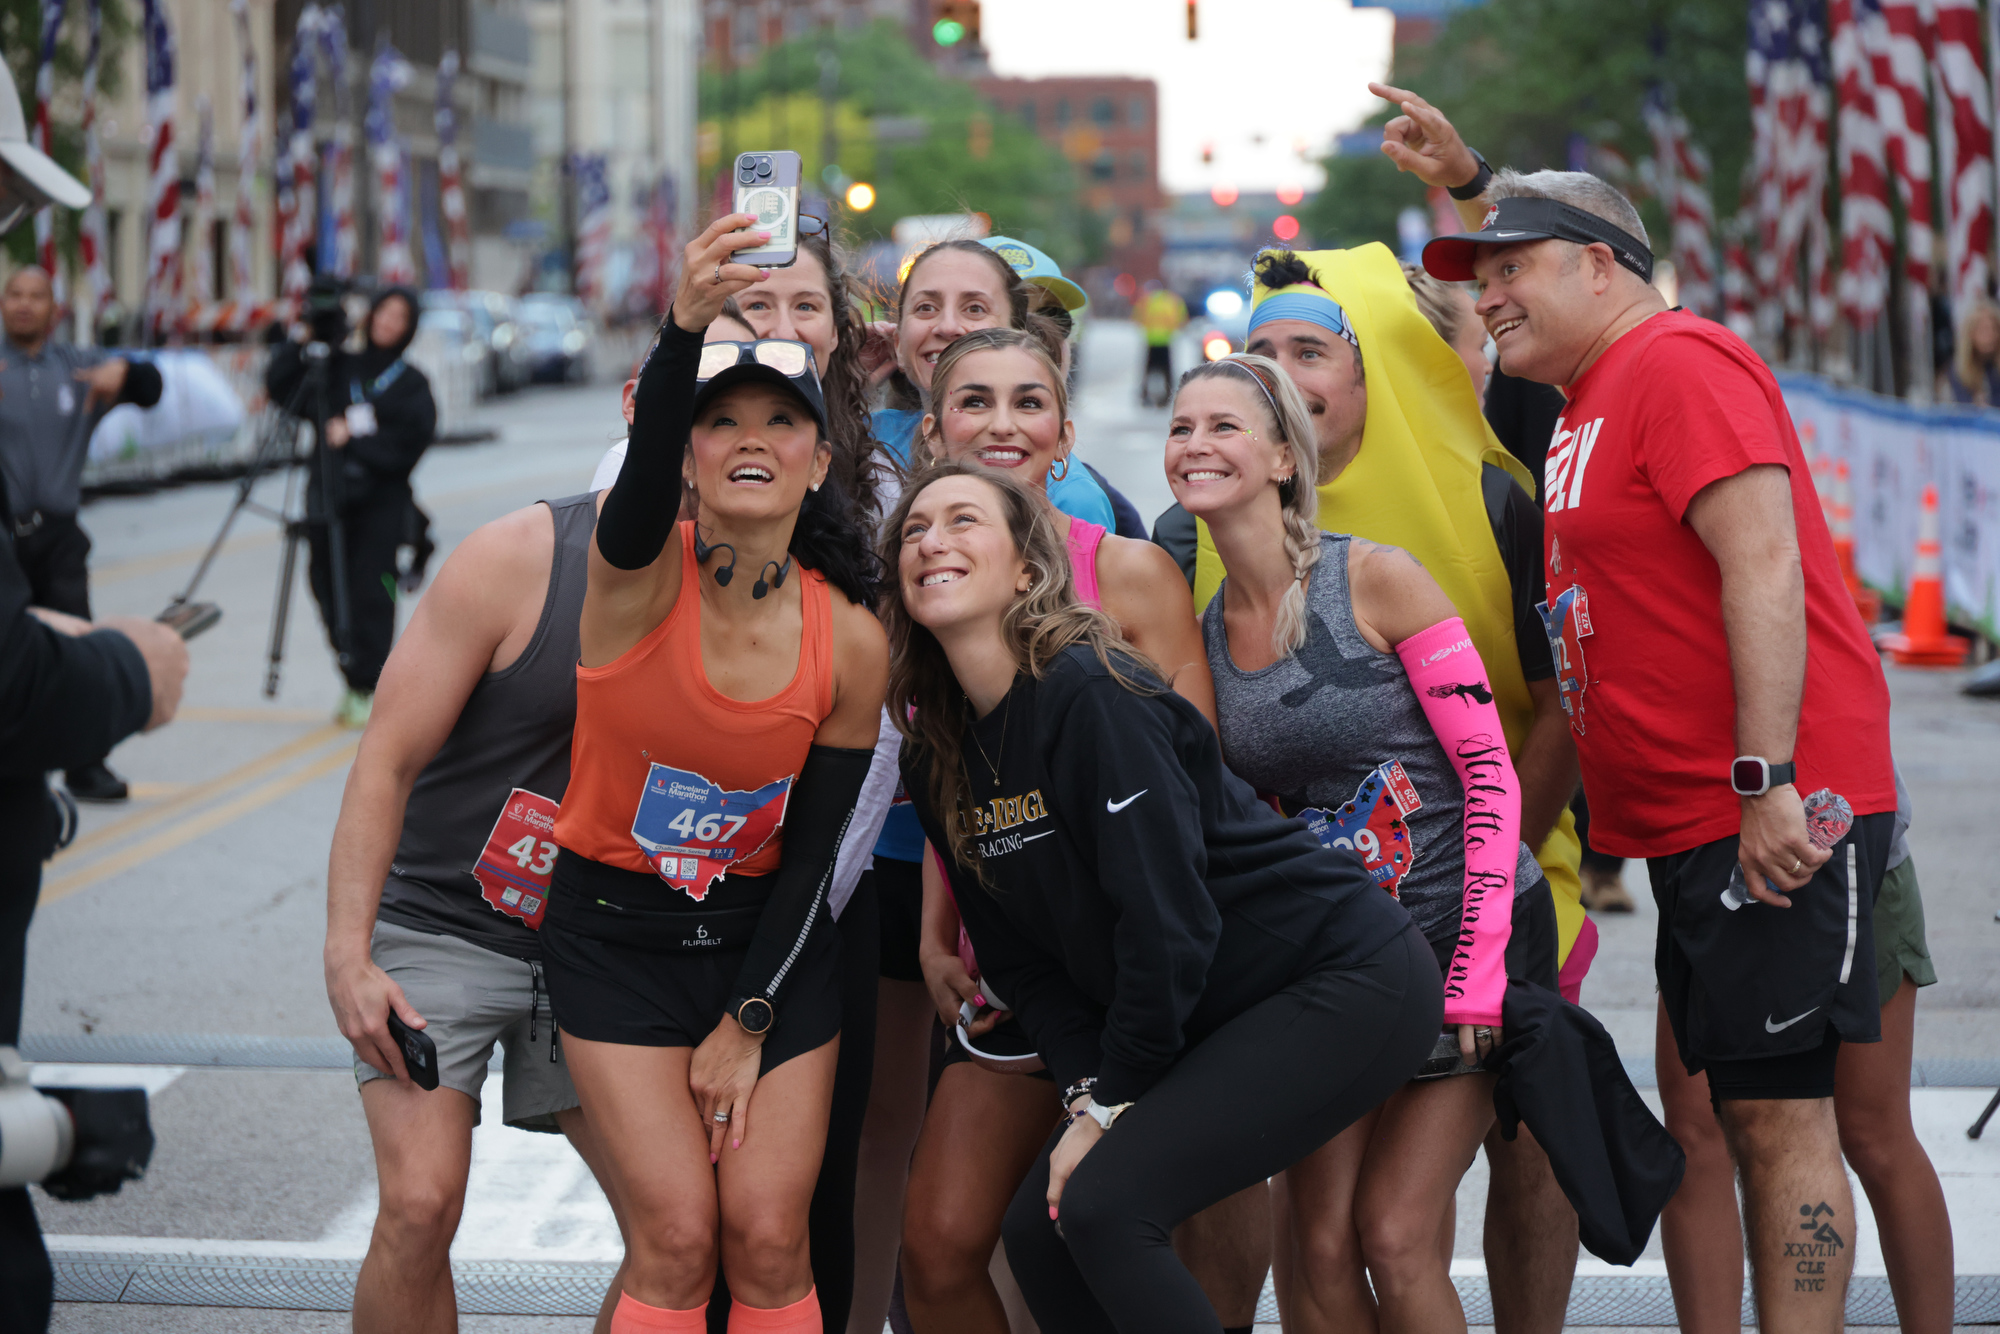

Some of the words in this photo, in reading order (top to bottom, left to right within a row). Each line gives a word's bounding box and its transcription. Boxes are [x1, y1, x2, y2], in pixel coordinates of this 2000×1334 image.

[1390, 765, 1404, 781] 529
[668, 788, 707, 802] Marathon
[670, 781, 709, 795] Cleveland
[1404, 788, 1418, 805] 529
[524, 814, 555, 832] Maratho
[527, 808, 555, 824] Clevela
[668, 808, 748, 843] 467
[978, 833, 1023, 858] RACING
[665, 860, 673, 872] B
[1371, 868, 1385, 876] 13.1
[682, 938, 722, 946] FLIPBELT
[1783, 1242, 1837, 1257] XXVI.II
[1796, 1261, 1826, 1274] CLE
[1794, 1278, 1826, 1292] NYC
